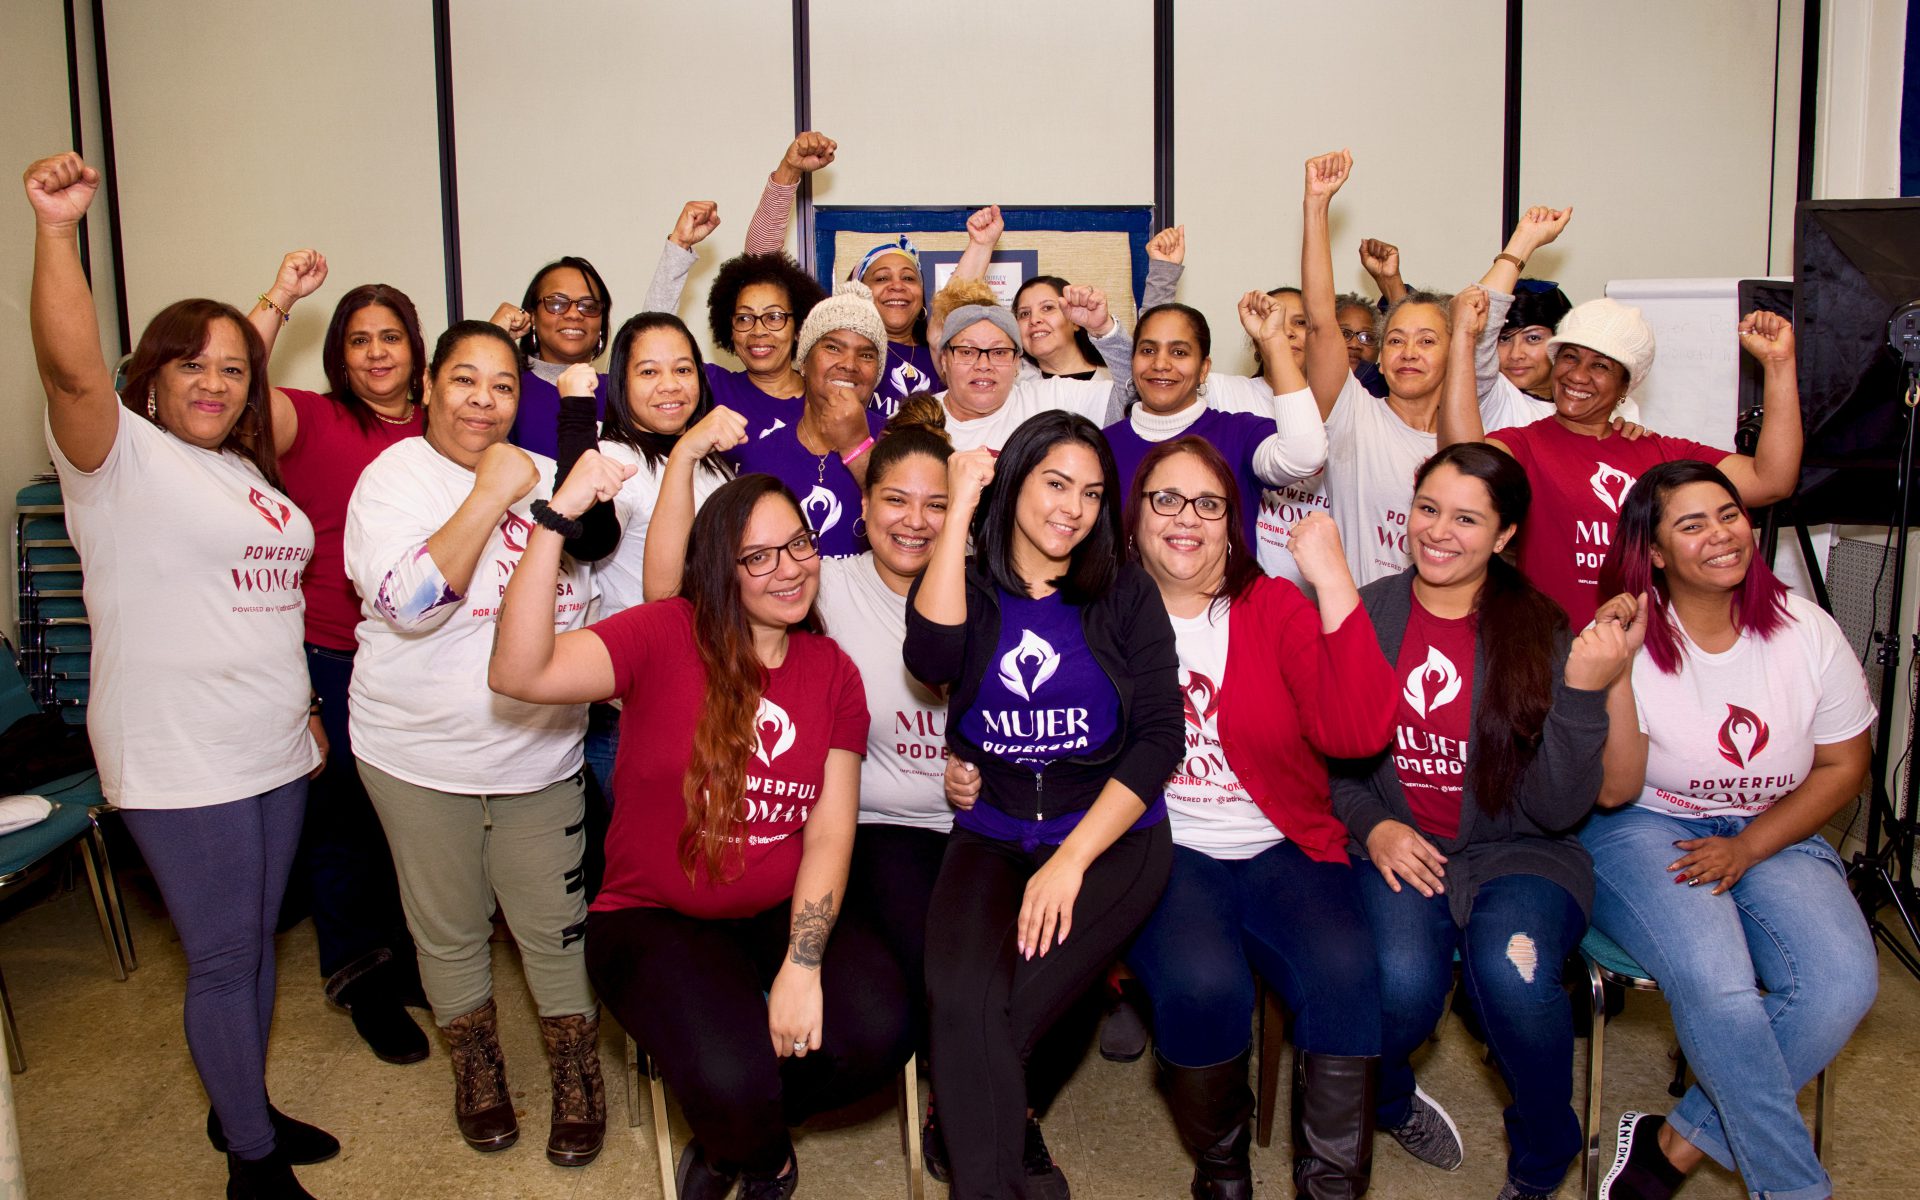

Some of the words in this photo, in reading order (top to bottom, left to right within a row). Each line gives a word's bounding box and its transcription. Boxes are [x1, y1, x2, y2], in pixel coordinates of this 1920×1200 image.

[473, 608, 490, 617] POR
[982, 707, 1089, 742] MUJER
[1690, 773, 1796, 790] POWERFUL
[1167, 793, 1201, 803] POWERED
[1620, 1113, 1635, 1145] DKNY
